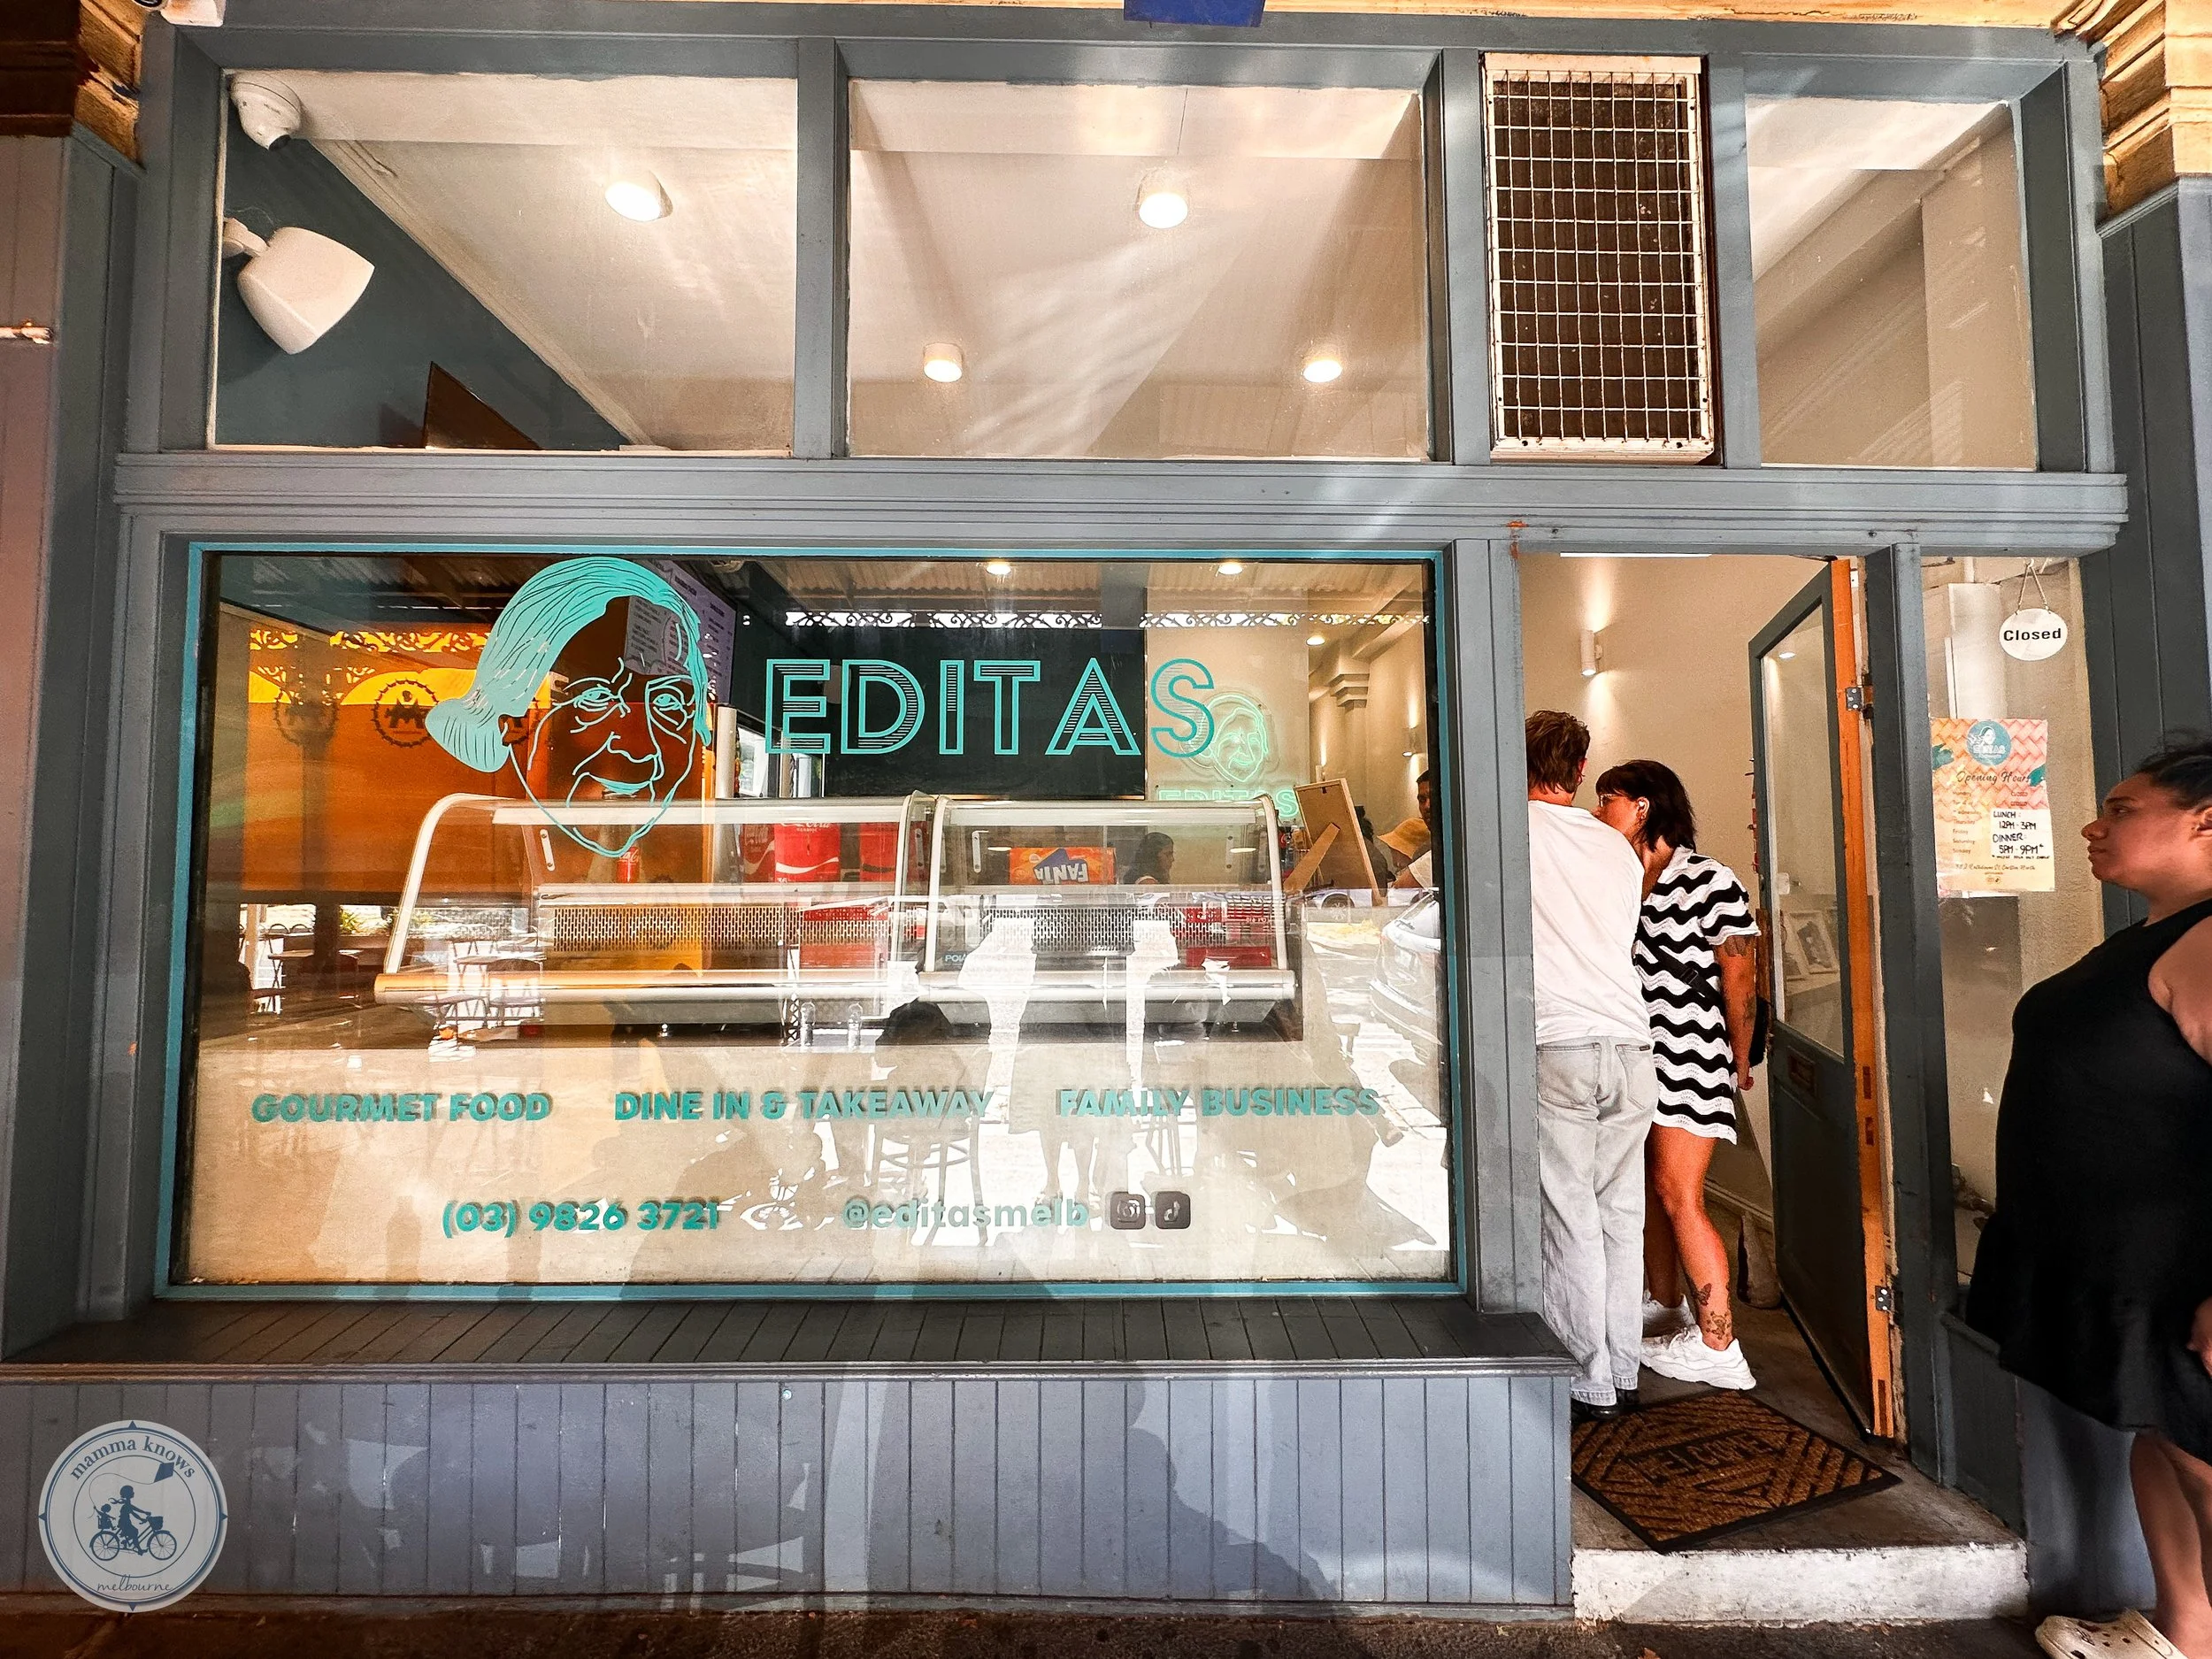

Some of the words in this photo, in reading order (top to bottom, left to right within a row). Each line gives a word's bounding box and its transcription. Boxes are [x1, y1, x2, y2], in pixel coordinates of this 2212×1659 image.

[2003, 627, 2062, 641] Closed
[764, 657, 1216, 758] EDITAS
[1955, 771, 1998, 785] Opening
[2001, 771, 2030, 783] Hours
[1033, 863, 1089, 884] FANTA
[251, 1092, 441, 1123] GOURMET
[449, 1092, 552, 1122] FOOD
[615, 1091, 704, 1121] DINE
[712, 1091, 751, 1121] IN
[761, 1091, 787, 1121] &
[796, 1089, 995, 1120] TAKEAWAY
[1059, 1088, 1190, 1118] FAMILY
[1201, 1087, 1382, 1118] BUSINESS
[442, 1200, 518, 1239] (03)
[528, 1201, 627, 1232] 9826
[636, 1201, 719, 1231] 3721
[842, 1197, 1090, 1228] @editasmelb
